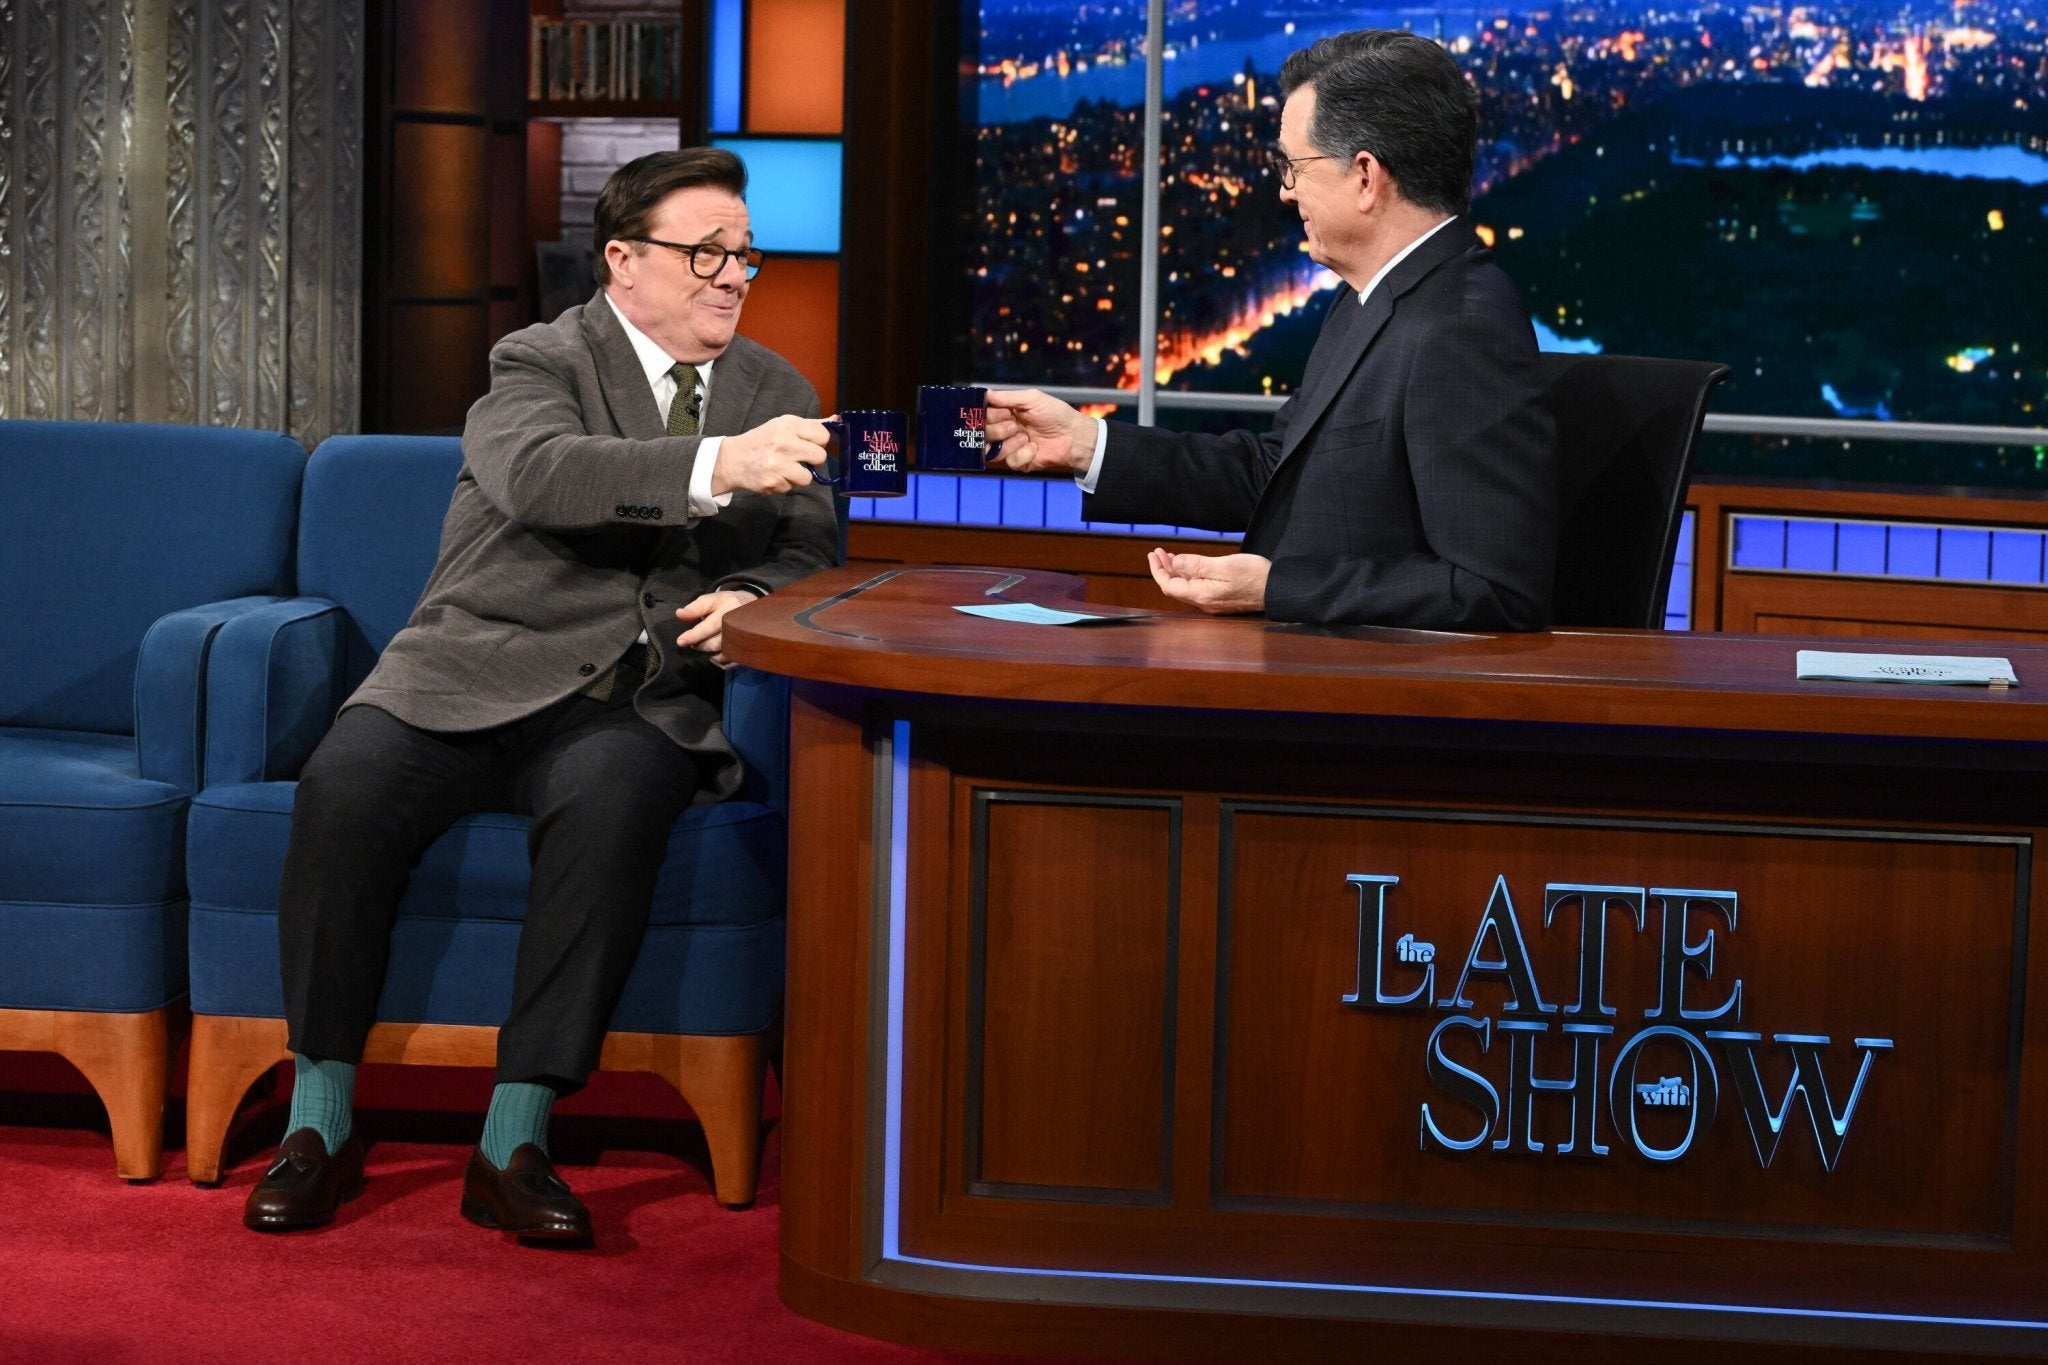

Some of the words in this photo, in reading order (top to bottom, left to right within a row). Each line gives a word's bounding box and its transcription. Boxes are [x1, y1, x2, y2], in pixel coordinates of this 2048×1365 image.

[863, 430, 893, 442] LATE
[953, 427, 985, 442] stephen
[869, 441, 899, 453] SHOW
[959, 436, 985, 449] colbert
[858, 450, 895, 464] stephen
[1342, 873, 1743, 1024] LATE
[1397, 935, 1436, 963] the
[1420, 1014, 1895, 1174] SHOW
[1637, 1079, 1690, 1106] with
